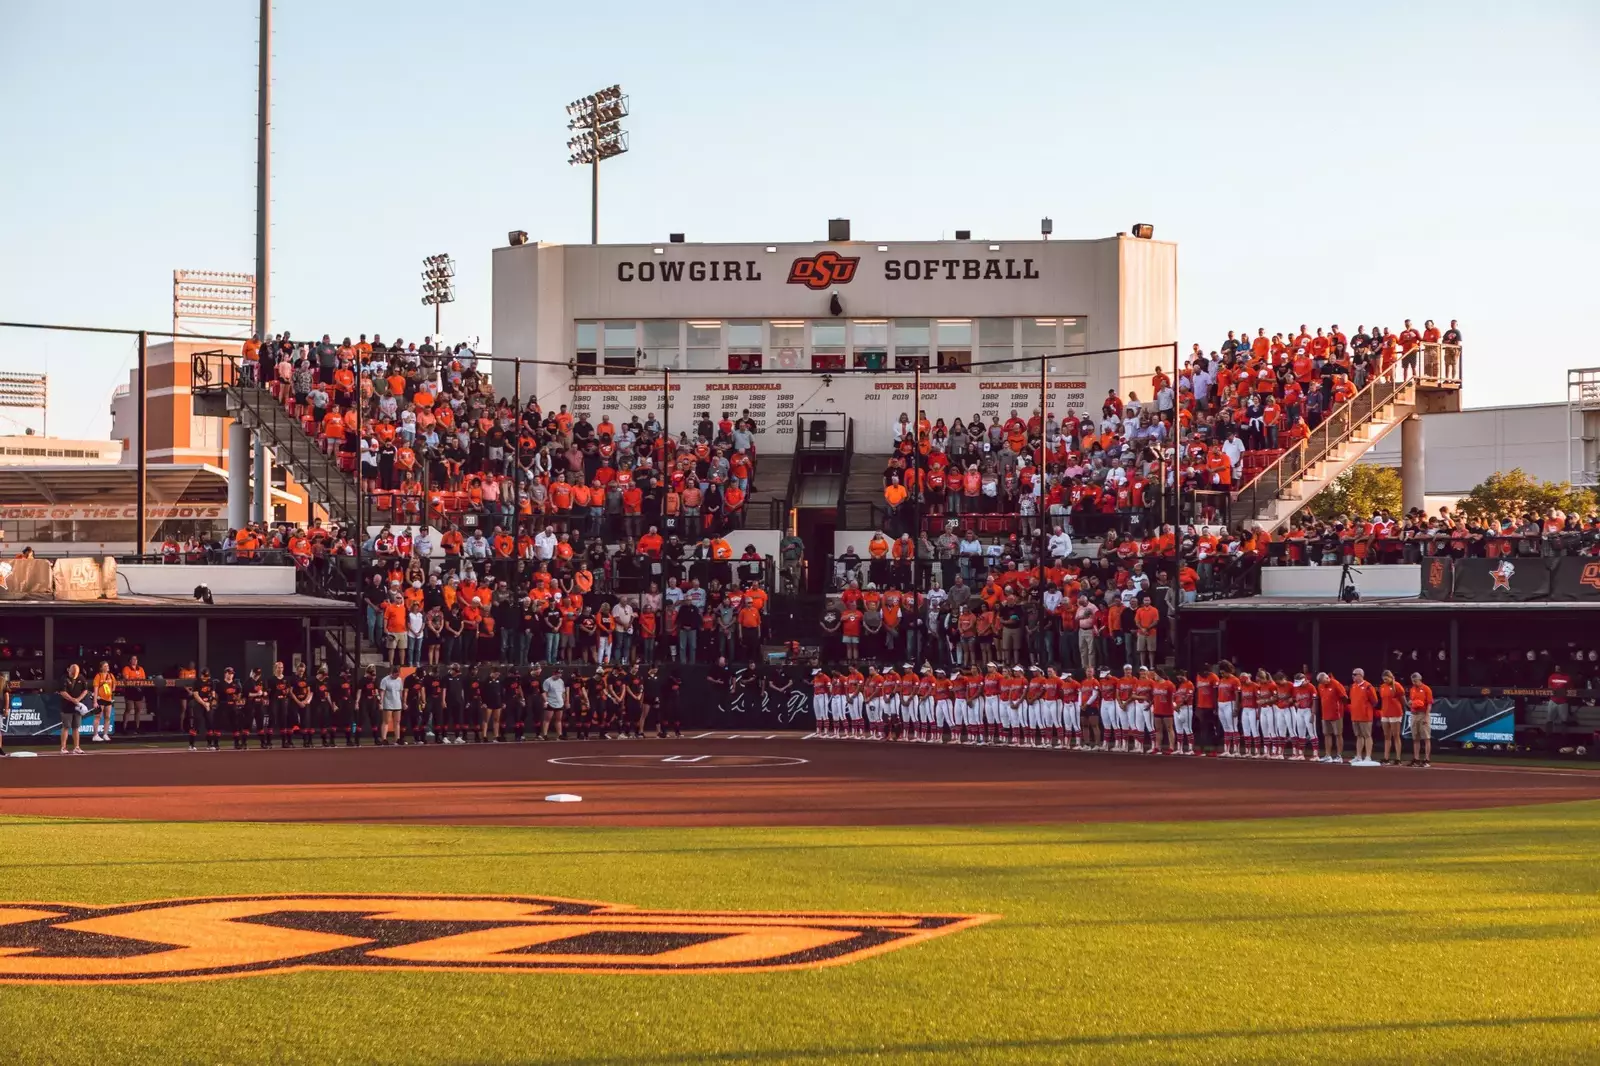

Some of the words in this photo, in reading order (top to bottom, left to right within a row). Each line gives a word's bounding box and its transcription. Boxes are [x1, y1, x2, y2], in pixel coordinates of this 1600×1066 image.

[618, 261, 761, 282] COWGIRL
[789, 253, 858, 288] OSU
[884, 259, 1039, 280] SOFTBALL
[569, 384, 626, 392] CONFERENCE
[732, 383, 782, 391] REGIONALS
[874, 382, 905, 390] SUPER
[979, 381, 1019, 390] COLLEGE
[1020, 381, 1052, 389] WORD
[1054, 381, 1087, 389] SERIES
[51, 508, 77, 519] OF
[83, 508, 118, 518] THE
[10, 712, 41, 721] SOFTBALL
